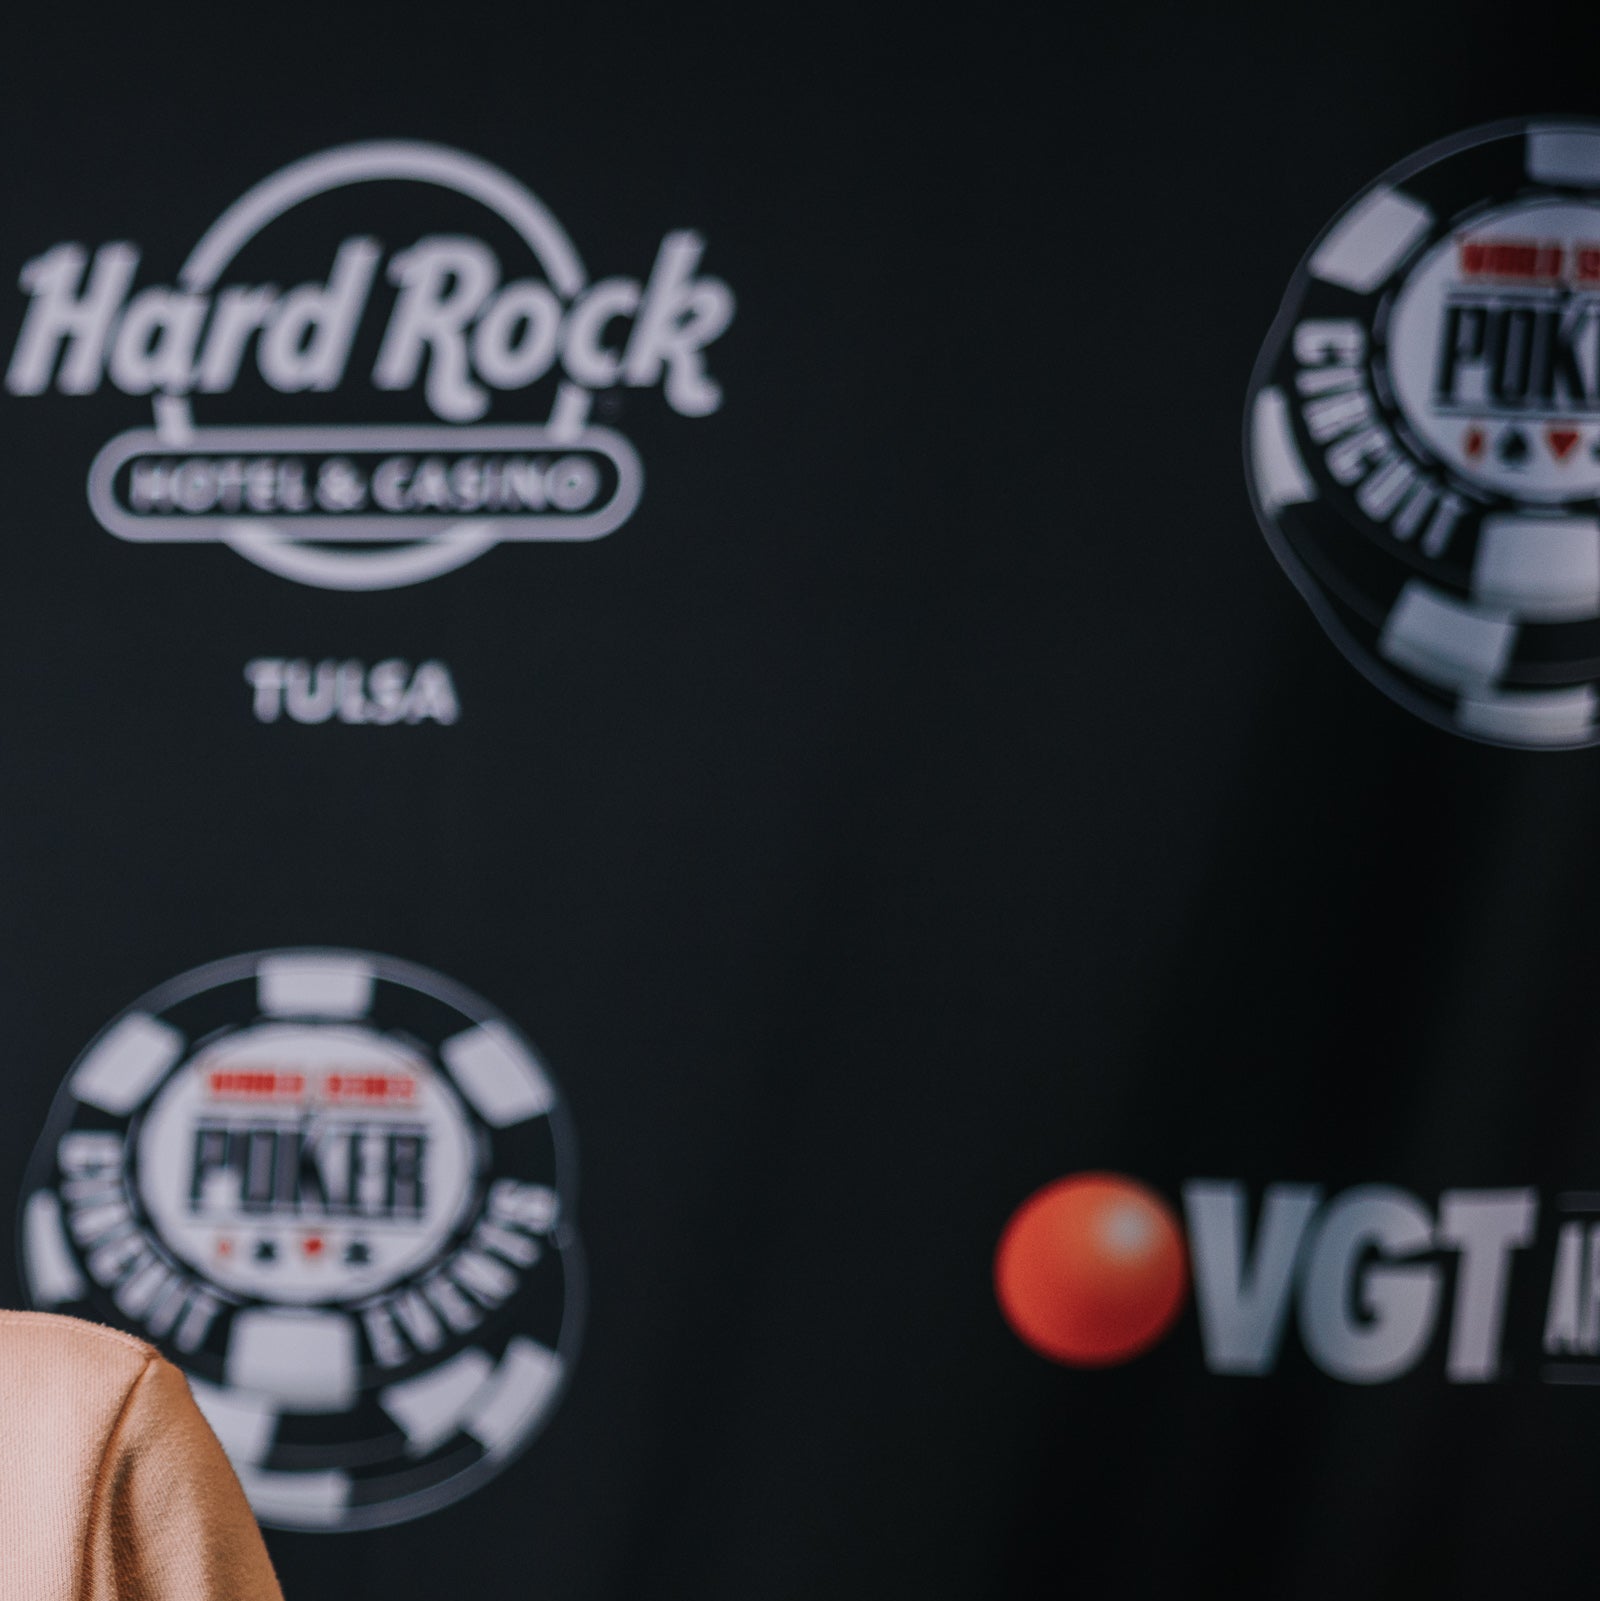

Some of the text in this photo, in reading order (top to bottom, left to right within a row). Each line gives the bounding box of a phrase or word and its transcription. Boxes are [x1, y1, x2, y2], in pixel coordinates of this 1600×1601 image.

[5, 228, 737, 424] Hard Rock
[1440, 302, 1600, 410] POK
[128, 454, 602, 514] HOTEL & CASINO
[245, 658, 462, 726] TULSA
[191, 1117, 425, 1220] POKER
[1182, 1177, 1540, 1386] VGT
